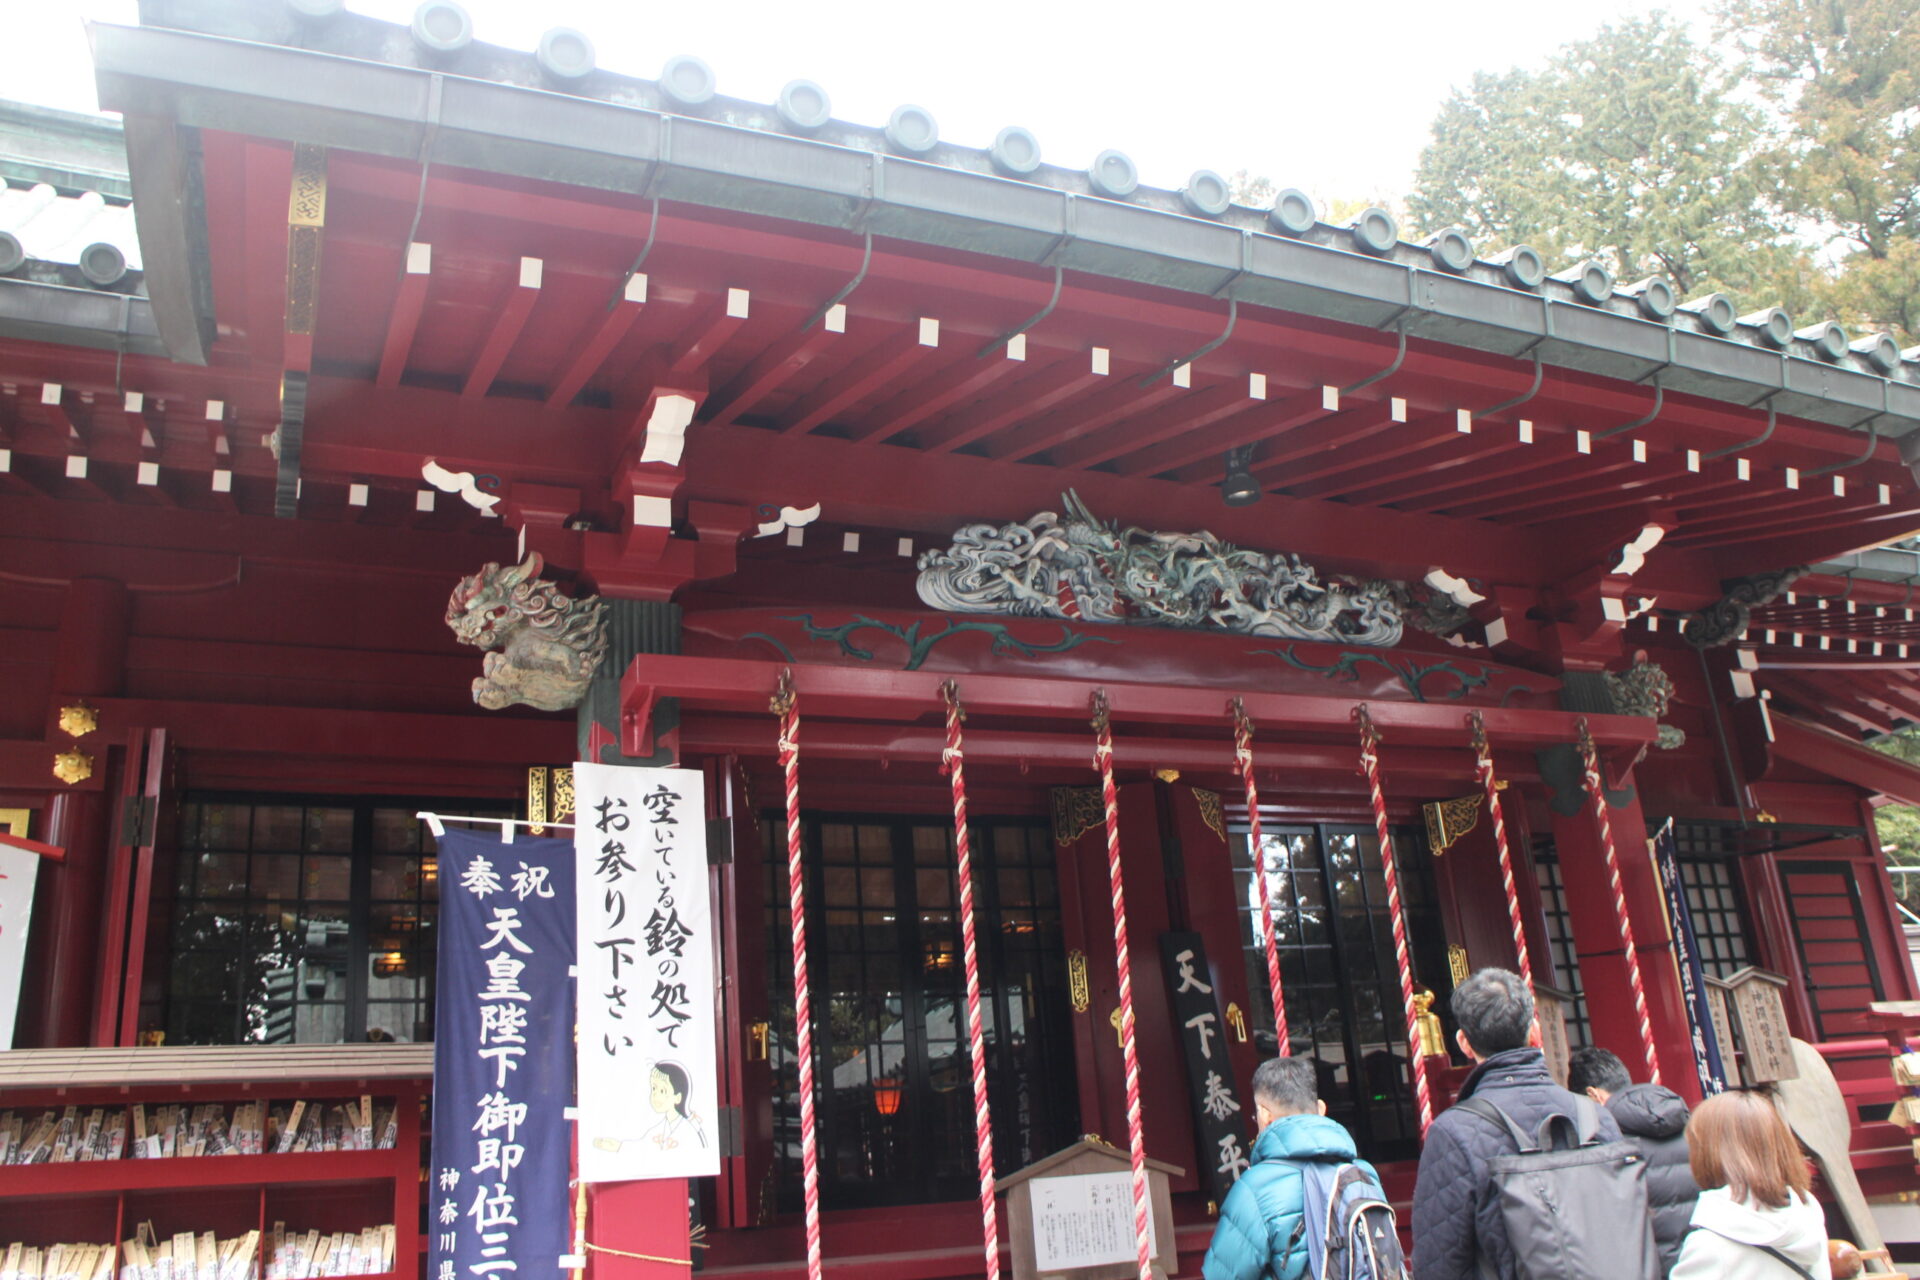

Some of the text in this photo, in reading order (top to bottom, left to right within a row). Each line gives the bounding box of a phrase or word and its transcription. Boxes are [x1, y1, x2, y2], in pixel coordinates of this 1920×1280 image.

[460, 854, 555, 902] 奉祝
[593, 797, 637, 1056] お参り下さい
[643, 784, 694, 1048] 空いている鈴の処で
[467, 907, 534, 1280] 天皇陛下御即位三
[1176, 949, 1250, 1181] 天下泰平
